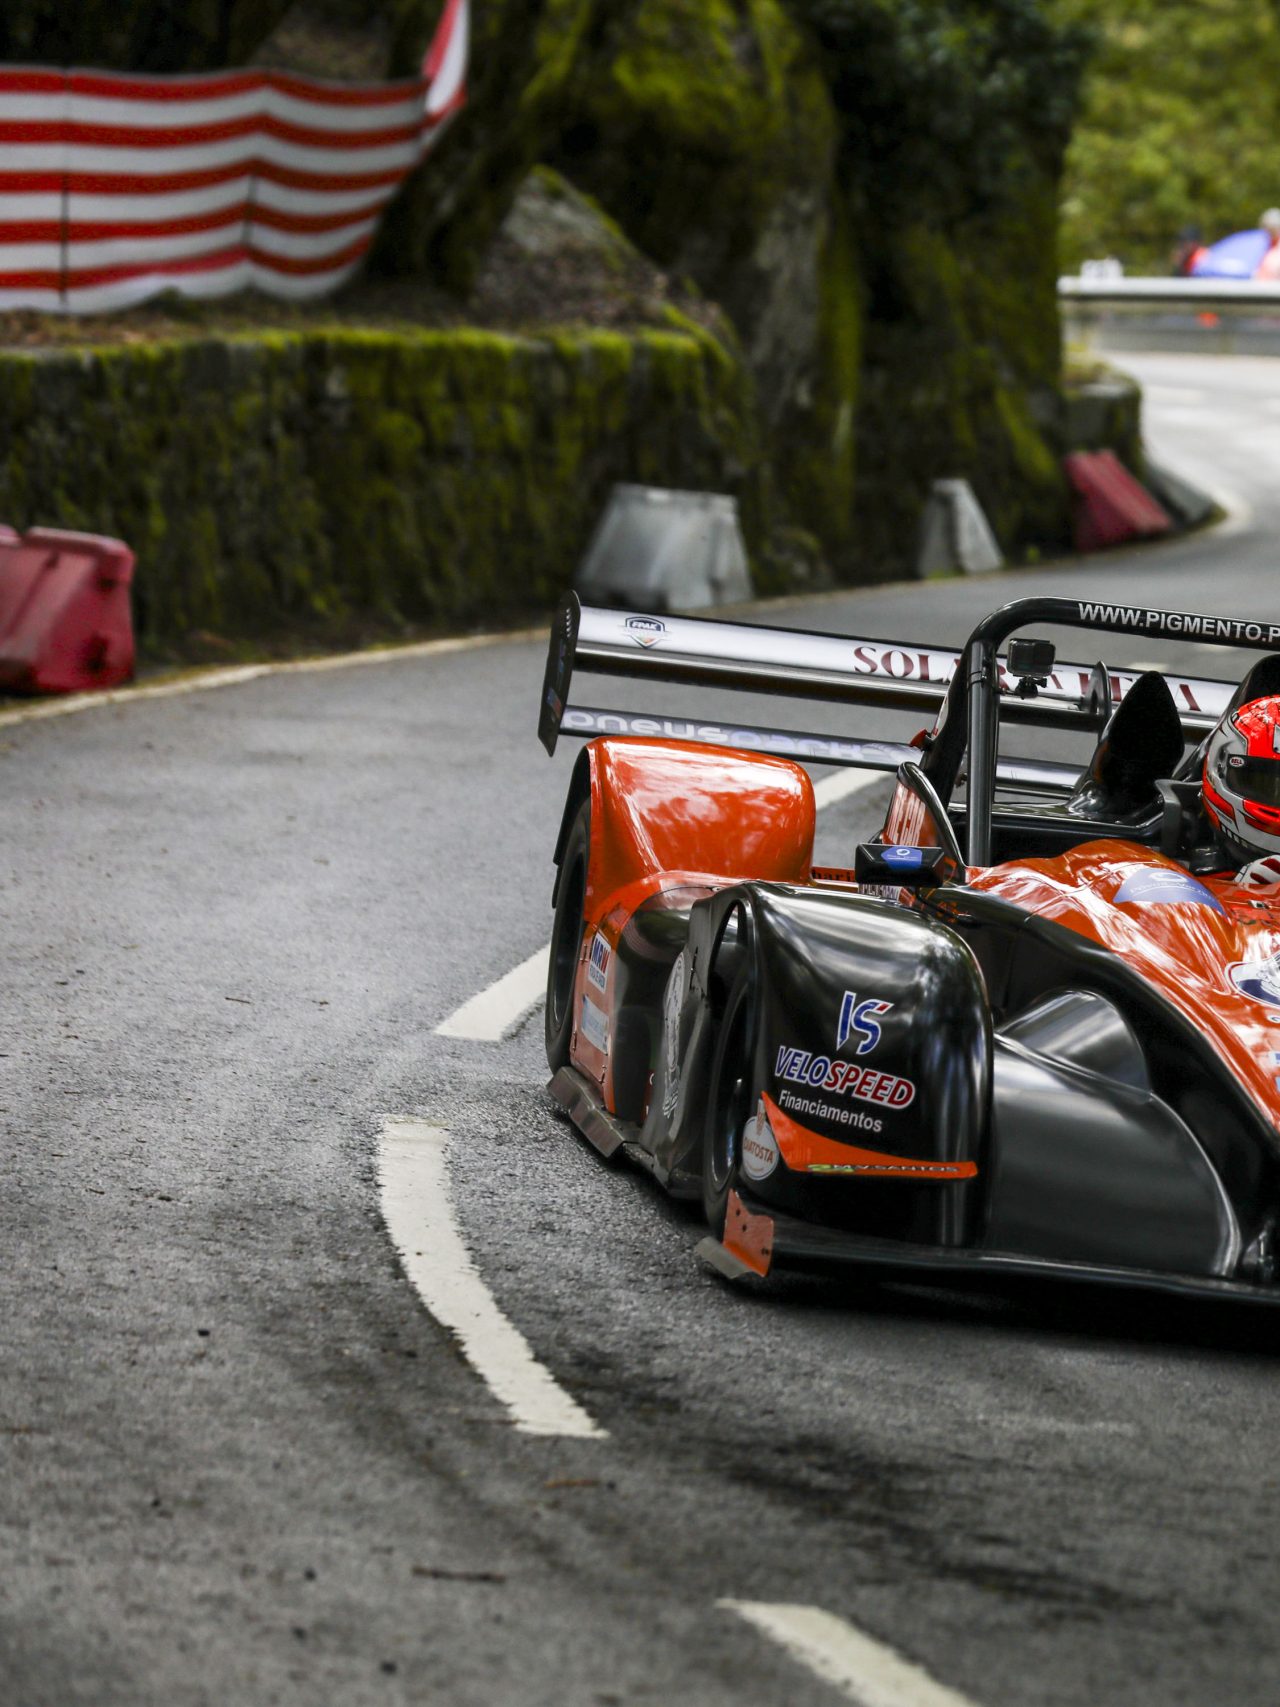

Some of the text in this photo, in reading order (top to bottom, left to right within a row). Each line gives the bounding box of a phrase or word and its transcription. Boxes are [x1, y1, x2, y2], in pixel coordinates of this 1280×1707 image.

[631, 621, 659, 632] FPAK
[774, 1045, 916, 1110] VELOSPEED
[778, 1089, 883, 1133] Financiamentos
